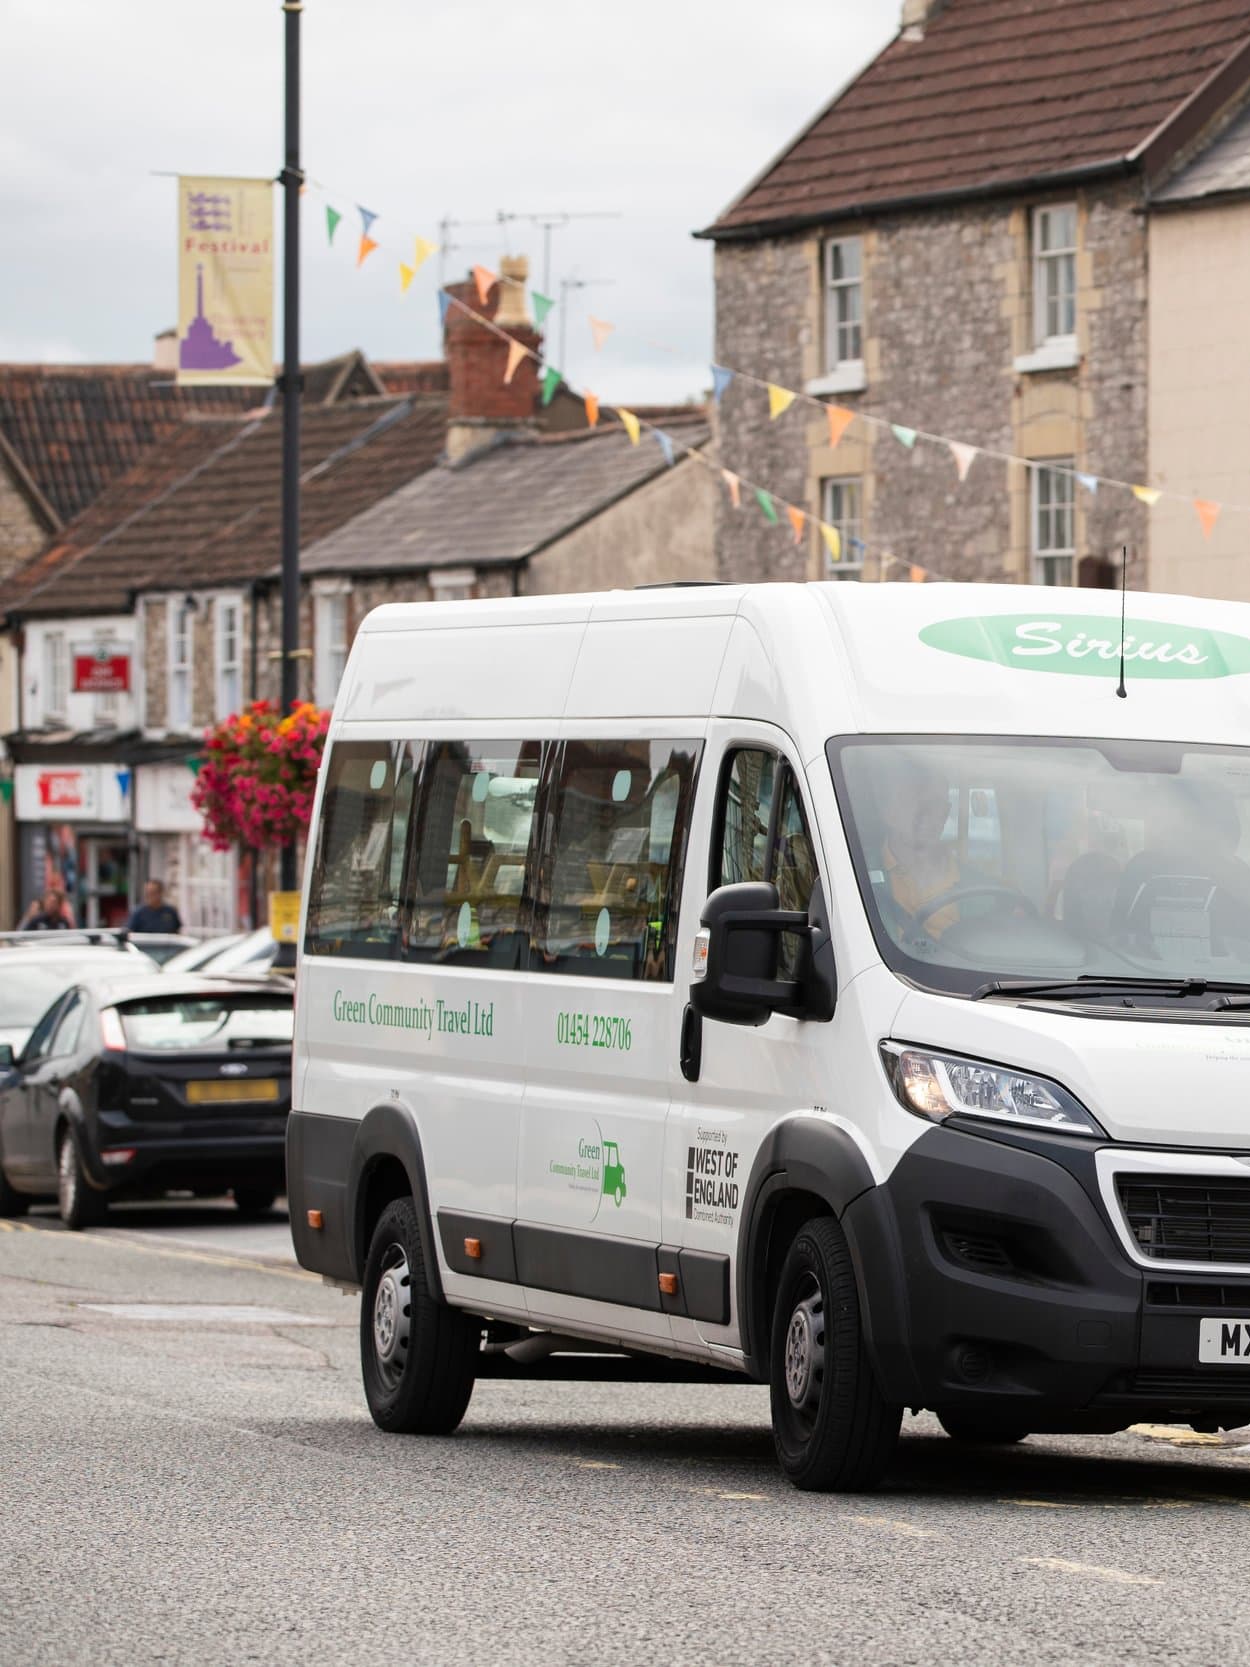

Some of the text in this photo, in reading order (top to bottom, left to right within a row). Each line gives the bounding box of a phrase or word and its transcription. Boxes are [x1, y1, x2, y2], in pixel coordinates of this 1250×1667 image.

[1012, 621, 1209, 665] Sirius
[334, 990, 494, 1040] Green Community Travel Ltd
[557, 1012, 632, 1051] 01454 228706
[579, 1137, 600, 1160] Green
[696, 1147, 739, 1179] WEST OF
[577, 1164, 591, 1179] Travel
[592, 1165, 600, 1181] Ltd
[694, 1178, 739, 1210] ENGLAND
